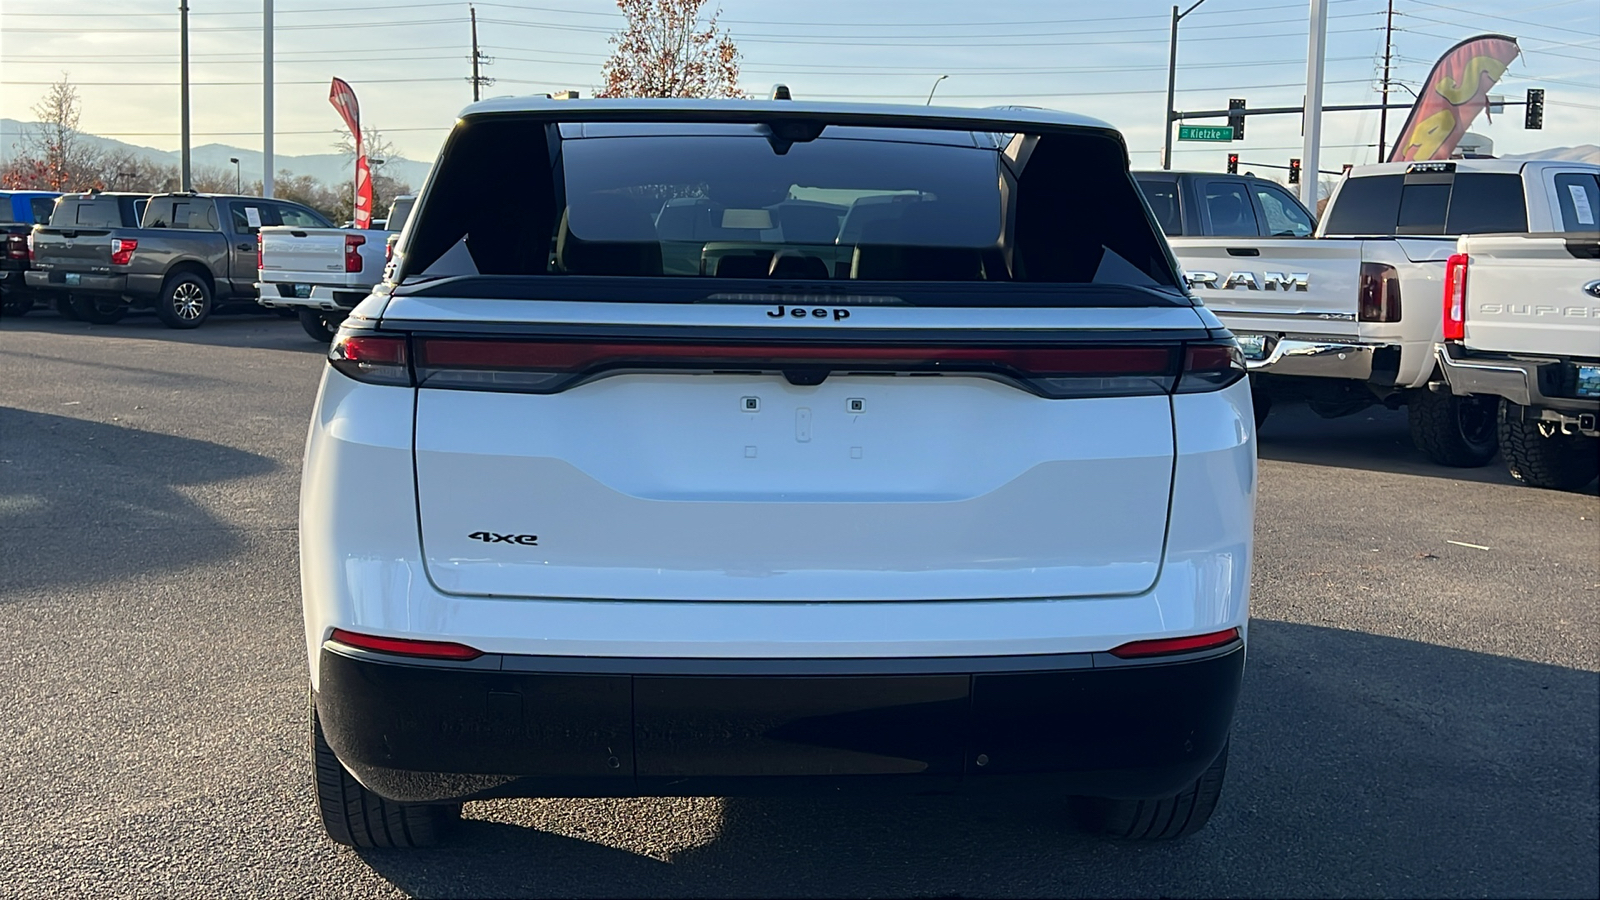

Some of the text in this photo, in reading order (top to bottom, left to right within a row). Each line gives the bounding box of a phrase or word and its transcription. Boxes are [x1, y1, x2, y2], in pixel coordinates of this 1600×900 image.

[1190, 128, 1221, 139] Kietzke
[1184, 270, 1310, 292] RAM
[767, 305, 851, 322] Jeep
[467, 531, 539, 546] 4xe
